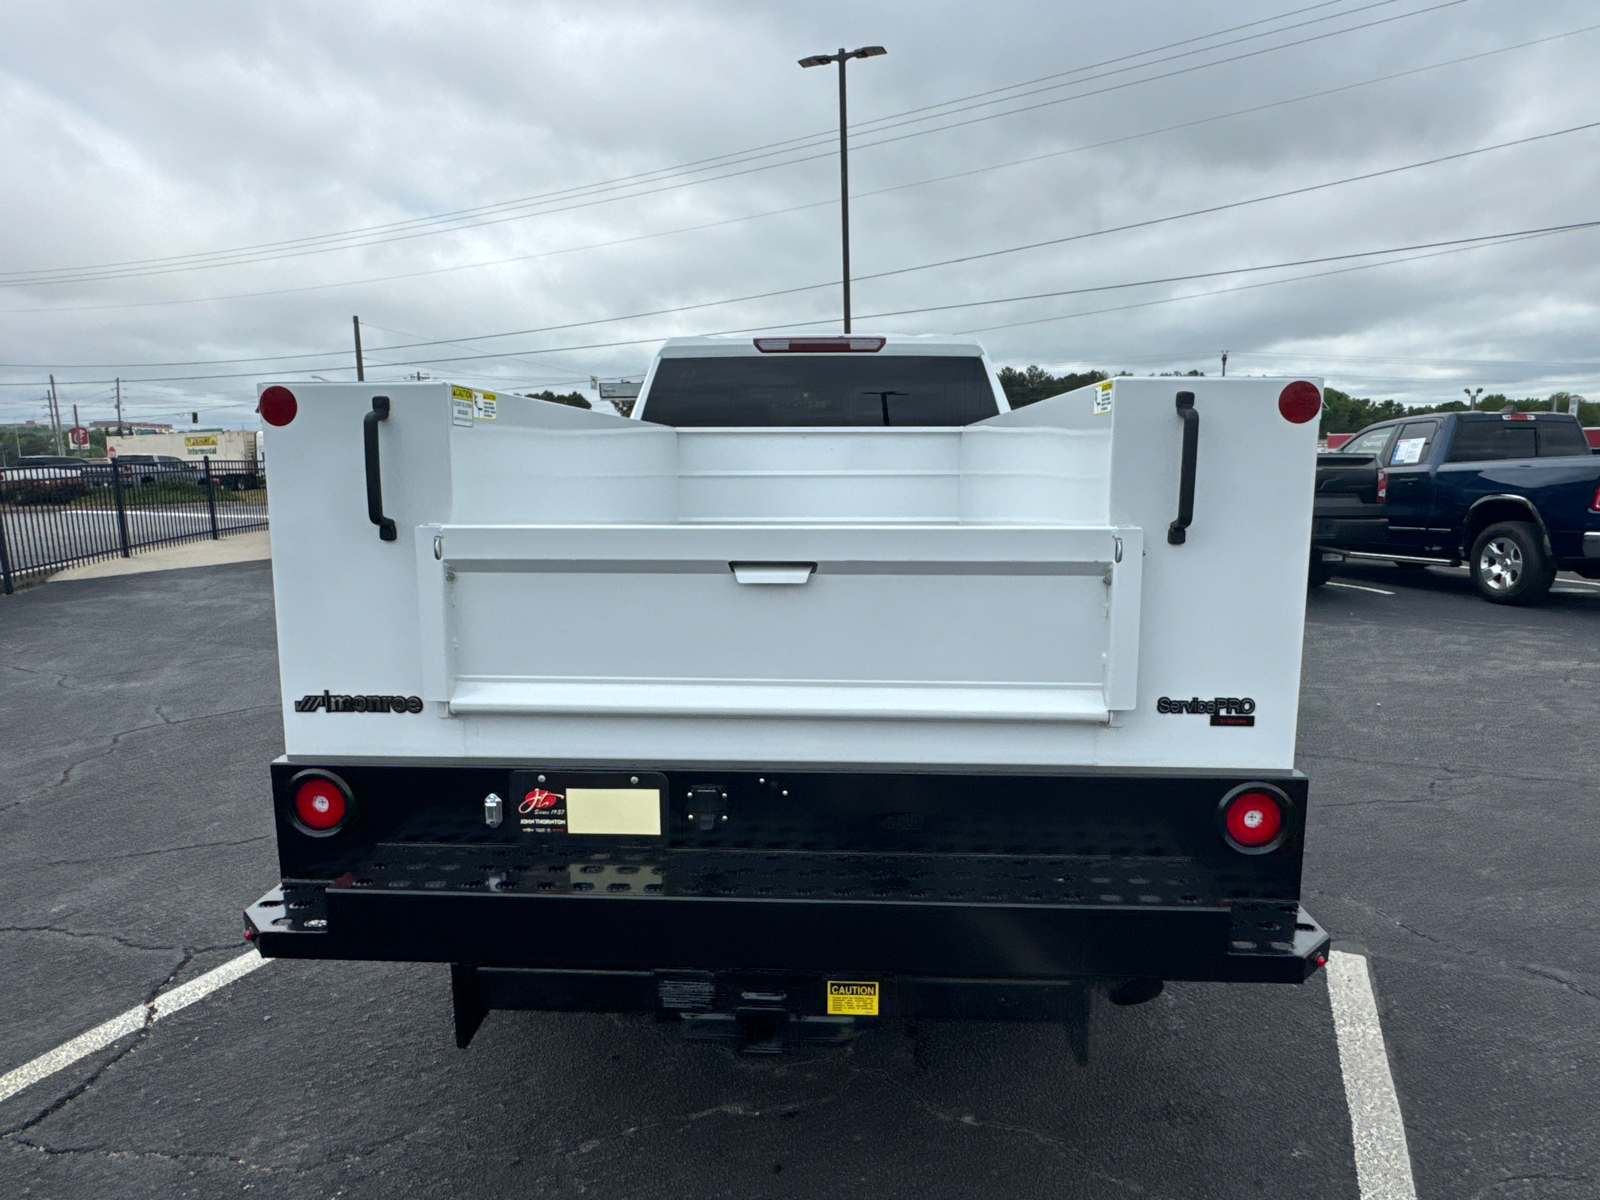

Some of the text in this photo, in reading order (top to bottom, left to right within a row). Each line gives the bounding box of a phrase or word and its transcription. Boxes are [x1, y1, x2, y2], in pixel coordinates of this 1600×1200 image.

[187, 447, 217, 455] Intermodal
[328, 694, 424, 714] monroe
[1157, 696, 1256, 715] ServicePRO
[831, 985, 875, 995] CAUTION
